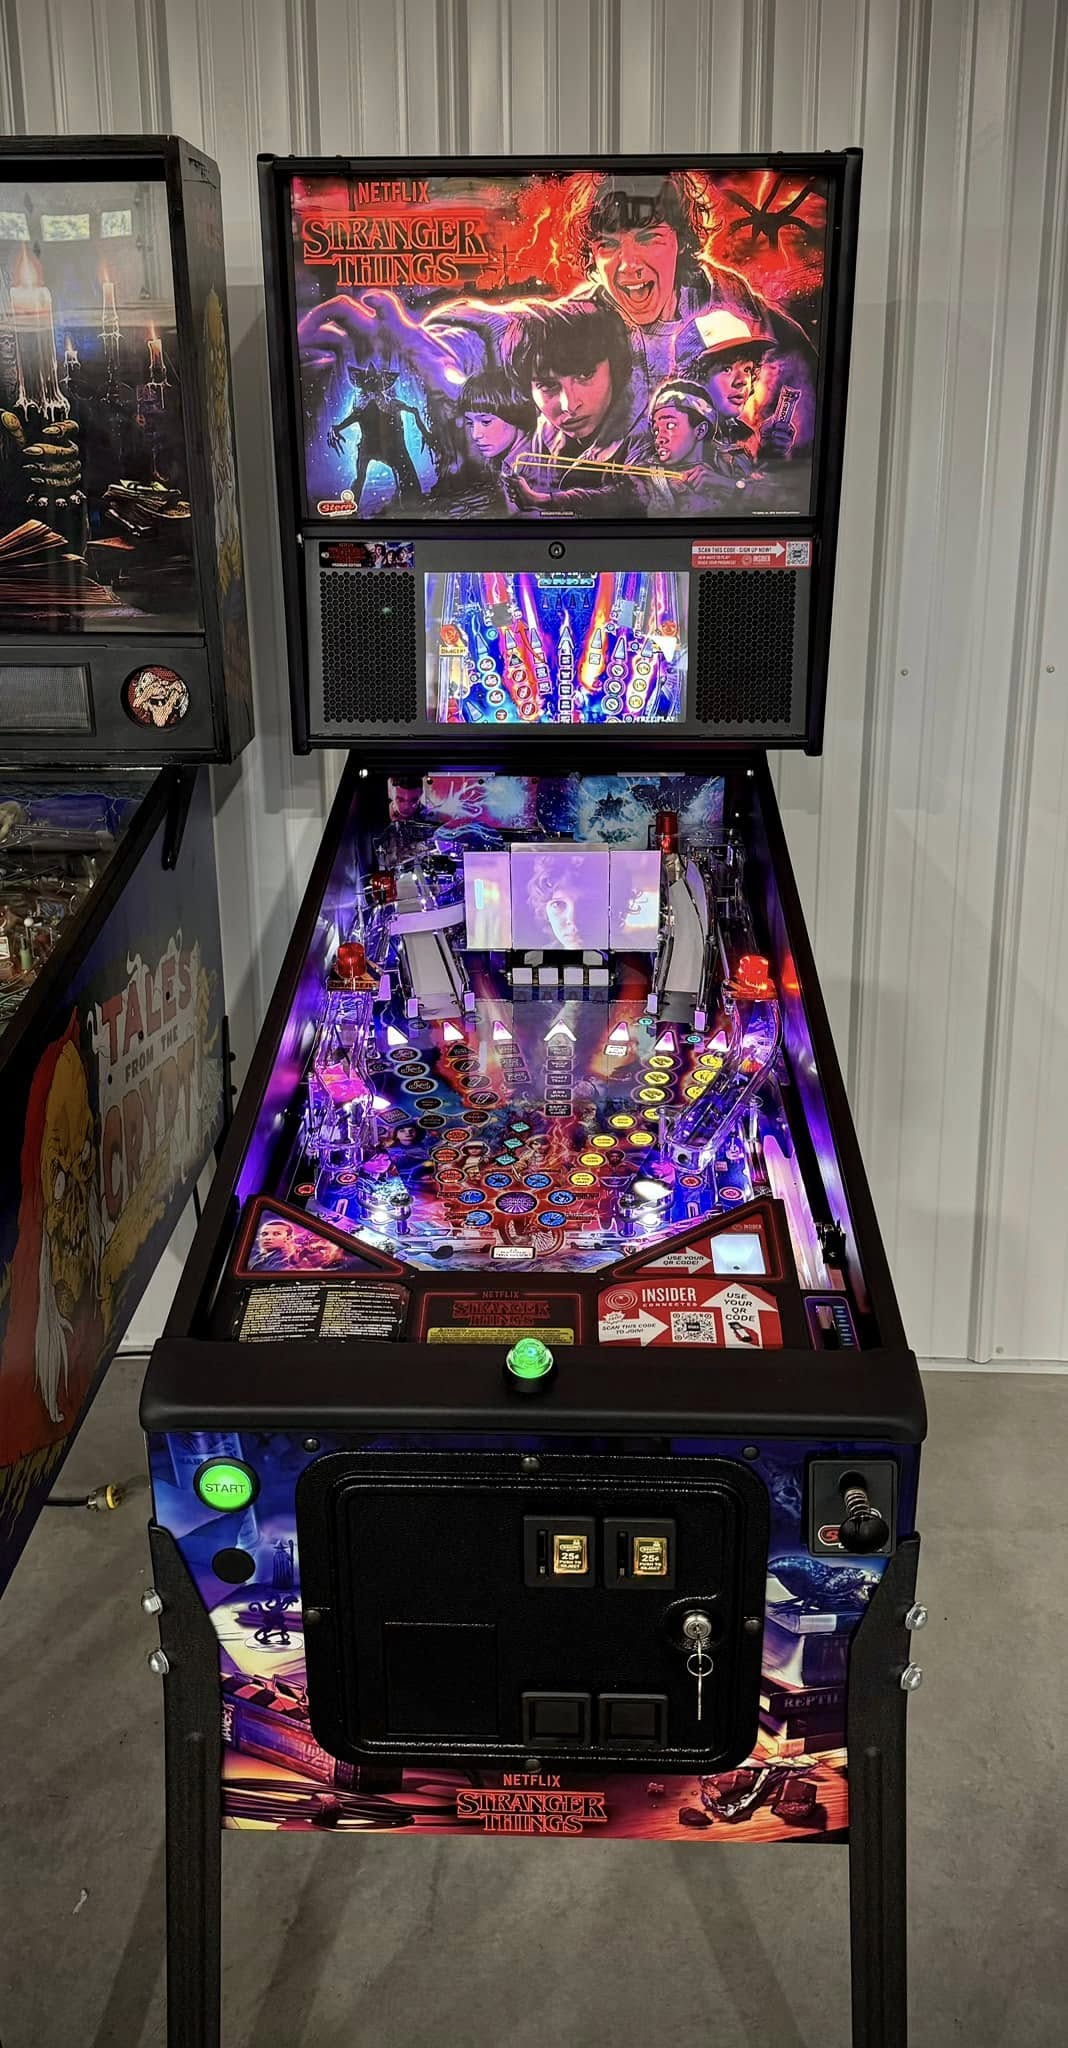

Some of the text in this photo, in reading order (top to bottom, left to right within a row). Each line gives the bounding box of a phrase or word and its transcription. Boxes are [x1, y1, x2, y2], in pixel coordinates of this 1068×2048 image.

[358, 181, 430, 204] NETFLIX
[302, 217, 488, 257] STRANGER
[332, 253, 459, 286] THINGS
[101, 951, 193, 1067] TALES
[124, 1025, 178, 1085] FROM THE
[104, 1037, 194, 1218] CRYPT
[482, 1291, 520, 1299] NETFLIX
[642, 1287, 697, 1302] INSIDER
[724, 1299, 753, 1307] YOUR
[725, 1314, 756, 1322] CODE
[205, 1483, 246, 1493] START
[503, 1774, 561, 1787] NETFLIX
[456, 1791, 608, 1819] STRANGER
[480, 1813, 583, 1834] THINGS
